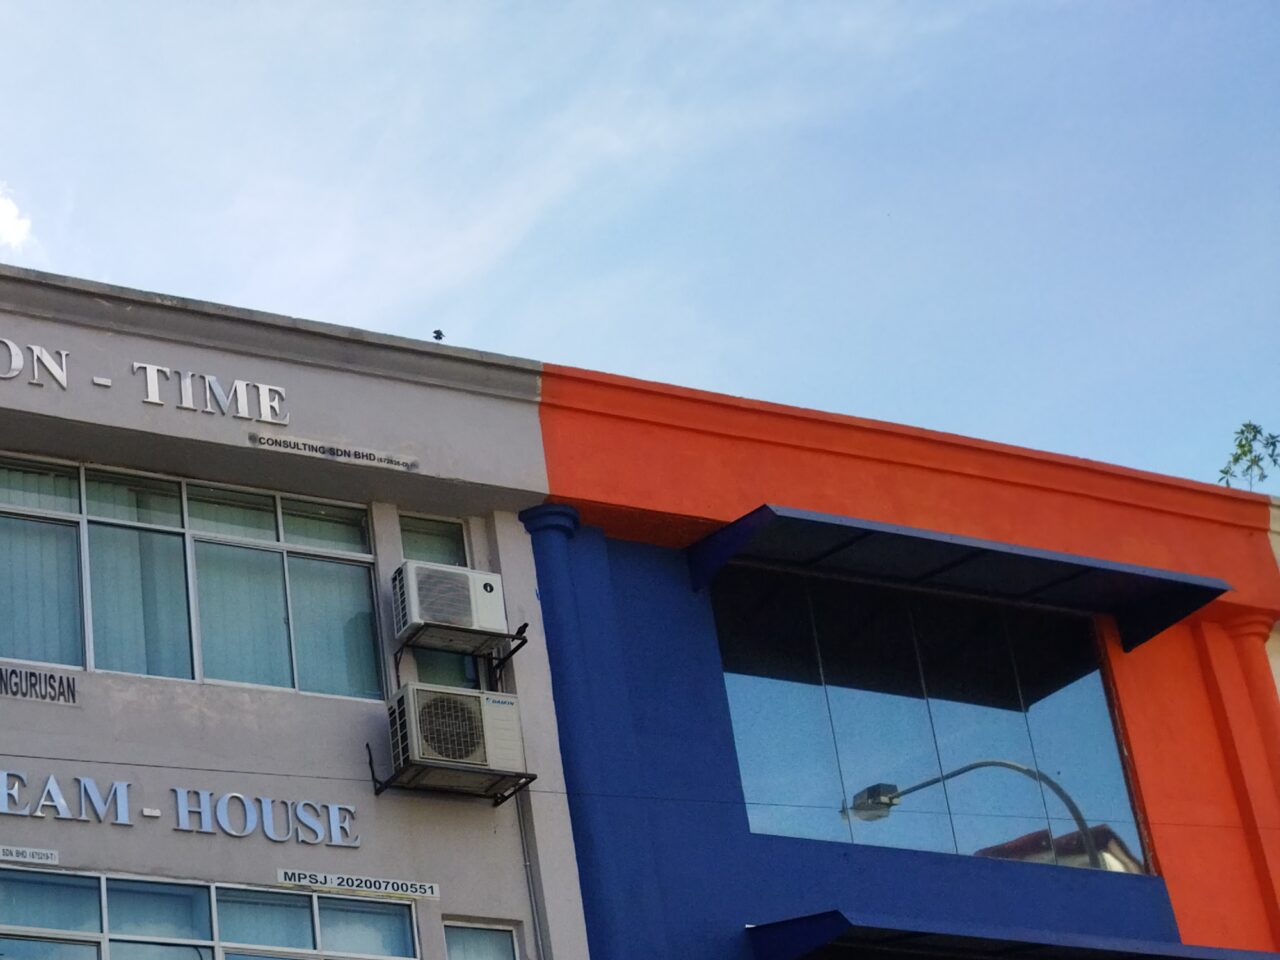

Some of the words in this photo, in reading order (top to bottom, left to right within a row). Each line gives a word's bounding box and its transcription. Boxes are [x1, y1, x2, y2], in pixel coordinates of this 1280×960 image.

[132, 361, 290, 426] TIME
[258, 436, 326, 456] CONSULTING
[328, 446, 352, 459] SDN
[353, 450, 376, 462] BHD
[1, 848, 14, 857] SDN
[336, 876, 436, 896] 20200700551
